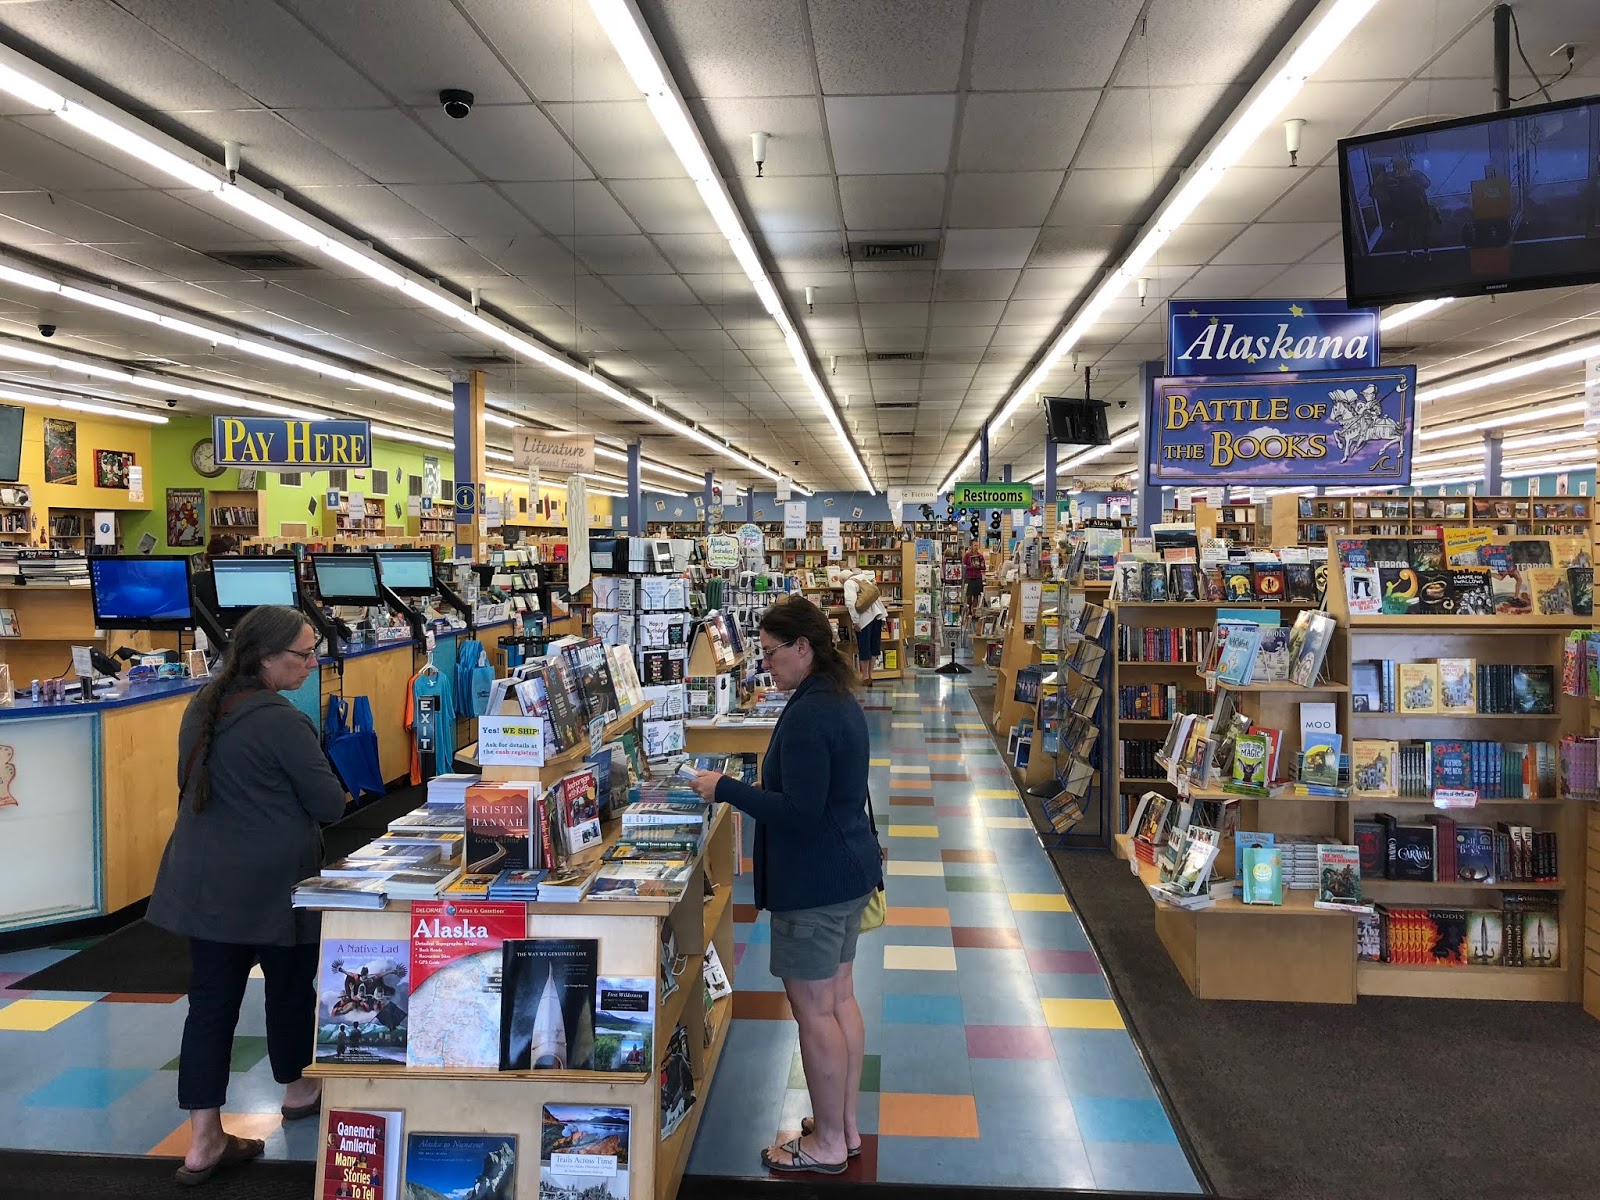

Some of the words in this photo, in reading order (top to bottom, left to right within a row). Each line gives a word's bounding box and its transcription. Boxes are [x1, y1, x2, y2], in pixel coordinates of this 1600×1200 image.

[1177, 323, 1369, 361] Alaskana
[1164, 394, 1290, 431] BATTLE
[1294, 404, 1328, 420] OF
[221, 419, 275, 462] PAY
[284, 420, 366, 464] HERE
[523, 436, 586, 457] Literature
[1163, 443, 1205, 460] THE
[1209, 430, 1328, 468] BOOKS
[524, 456, 531, 466] &
[561, 459, 584, 470] Fiction
[963, 489, 1023, 502] Restrooms
[1349, 599, 1380, 607] WEDNESDAY
[420, 700, 432, 749] EXIT
[517, 727, 540, 735] SHIP!
[1305, 721, 1331, 730] MOO
[1240, 749, 1261, 758] MAGIC
[472, 805, 523, 814] KRISTIN
[472, 818, 523, 827] HANNAH
[1252, 887, 1273, 895] Smile
[1429, 912, 1465, 920] HADDIX
[413, 918, 489, 938] Alaska
[337, 944, 344, 953] A
[347, 944, 378, 953] Native
[381, 944, 399, 953] Lad
[337, 1121, 375, 1139] Qanemcit
[340, 1137, 377, 1155] Amllertut
[335, 1152, 357, 1170] Many
[555, 1155, 573, 1163] Trails
[343, 1168, 371, 1184] Stories
[351, 1184, 361, 1199] To
[362, 1185, 375, 1200] Tell
